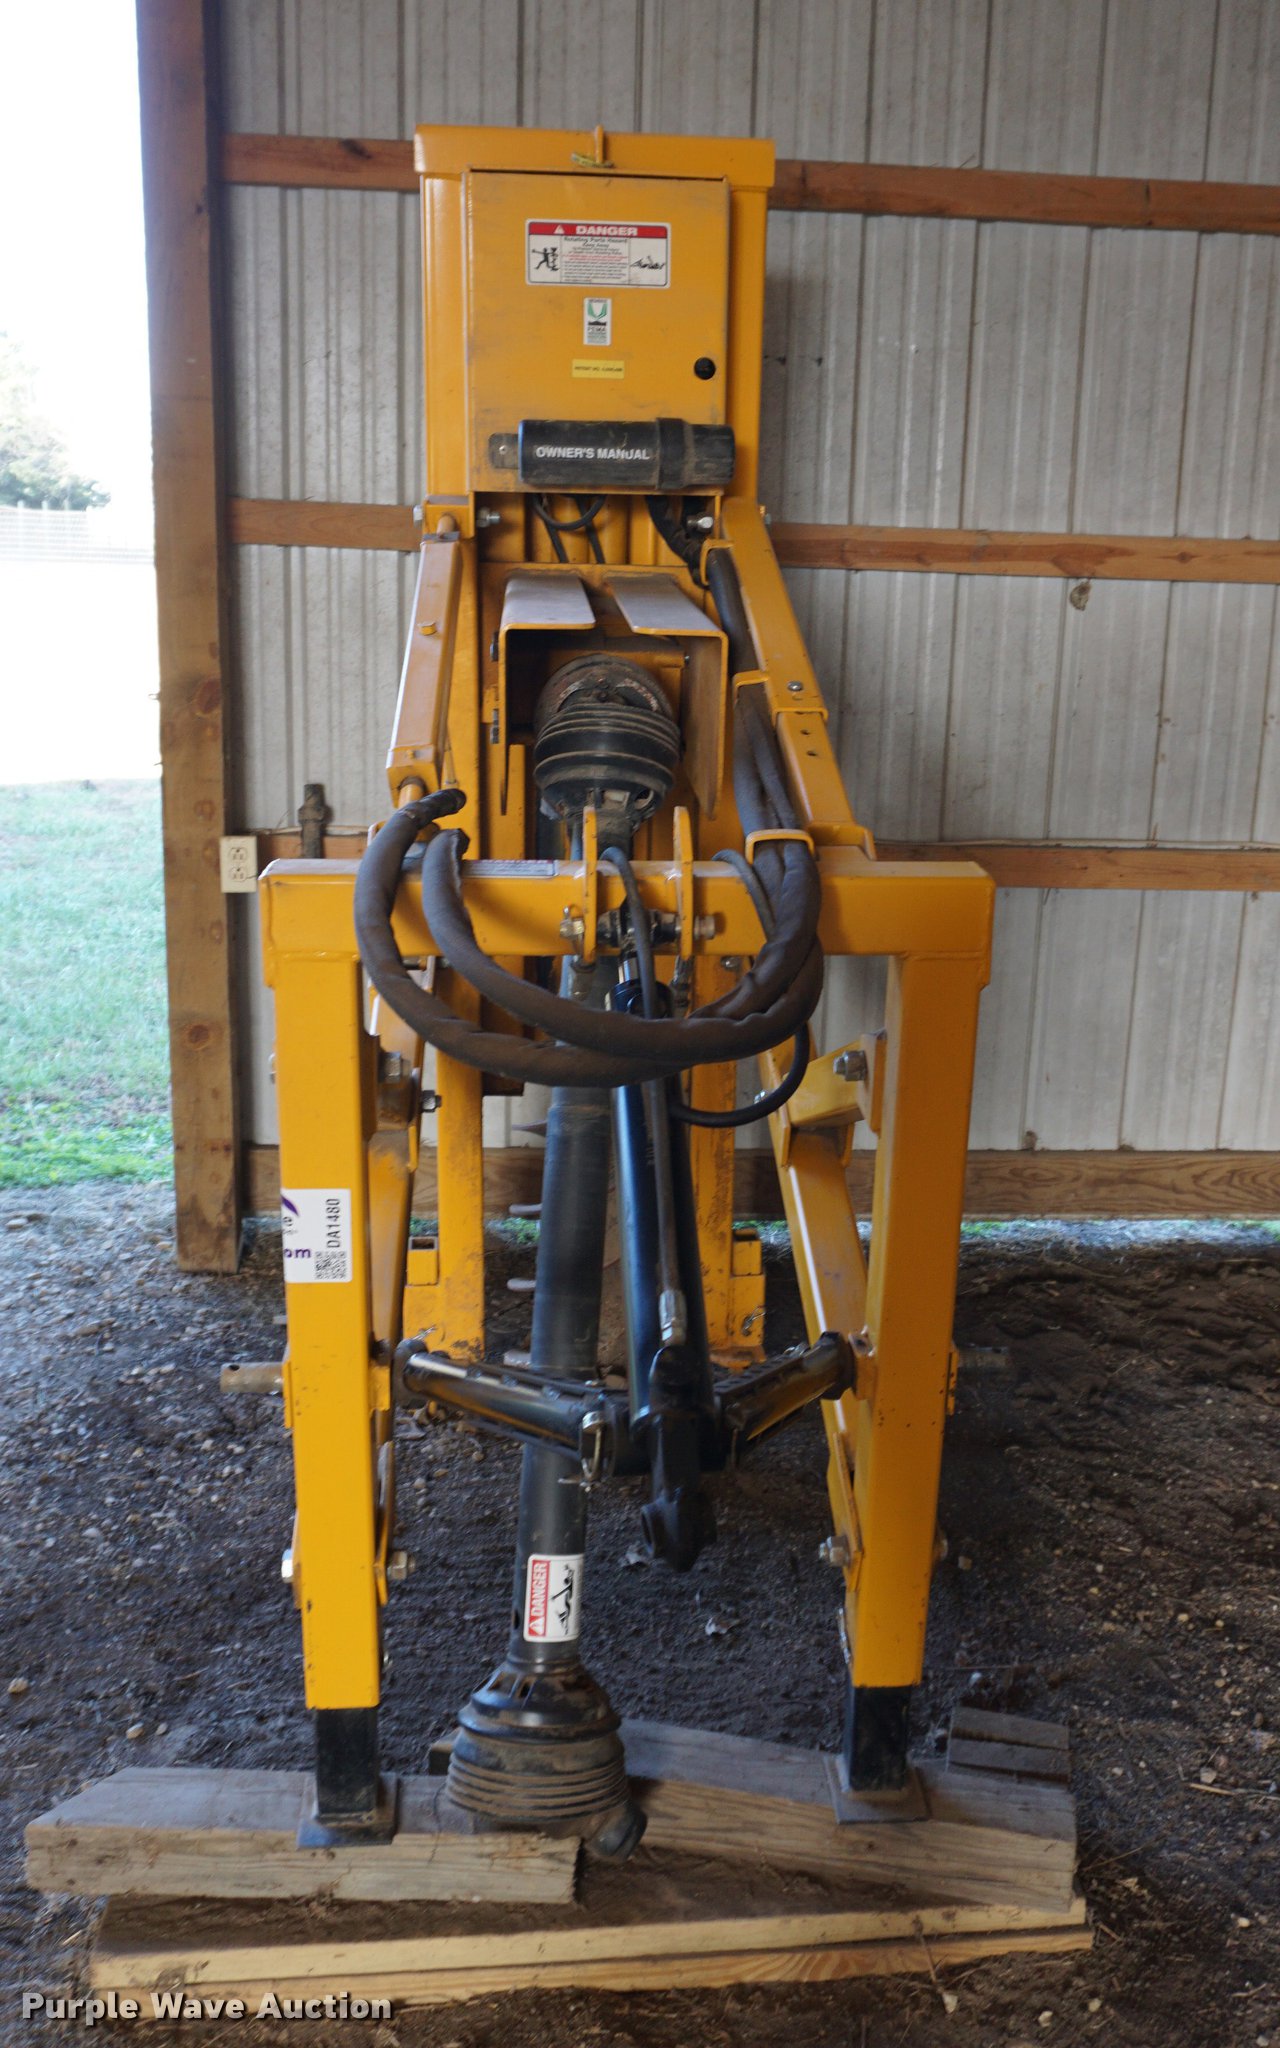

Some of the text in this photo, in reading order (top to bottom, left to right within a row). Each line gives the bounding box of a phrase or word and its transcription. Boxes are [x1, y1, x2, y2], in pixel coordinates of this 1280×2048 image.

[575, 225, 638, 236] DANGER
[535, 446, 650, 460] OWNER'S MANUAL
[326, 1198, 341, 1249] DA1480
[530, 1562, 548, 1616] DANGER
